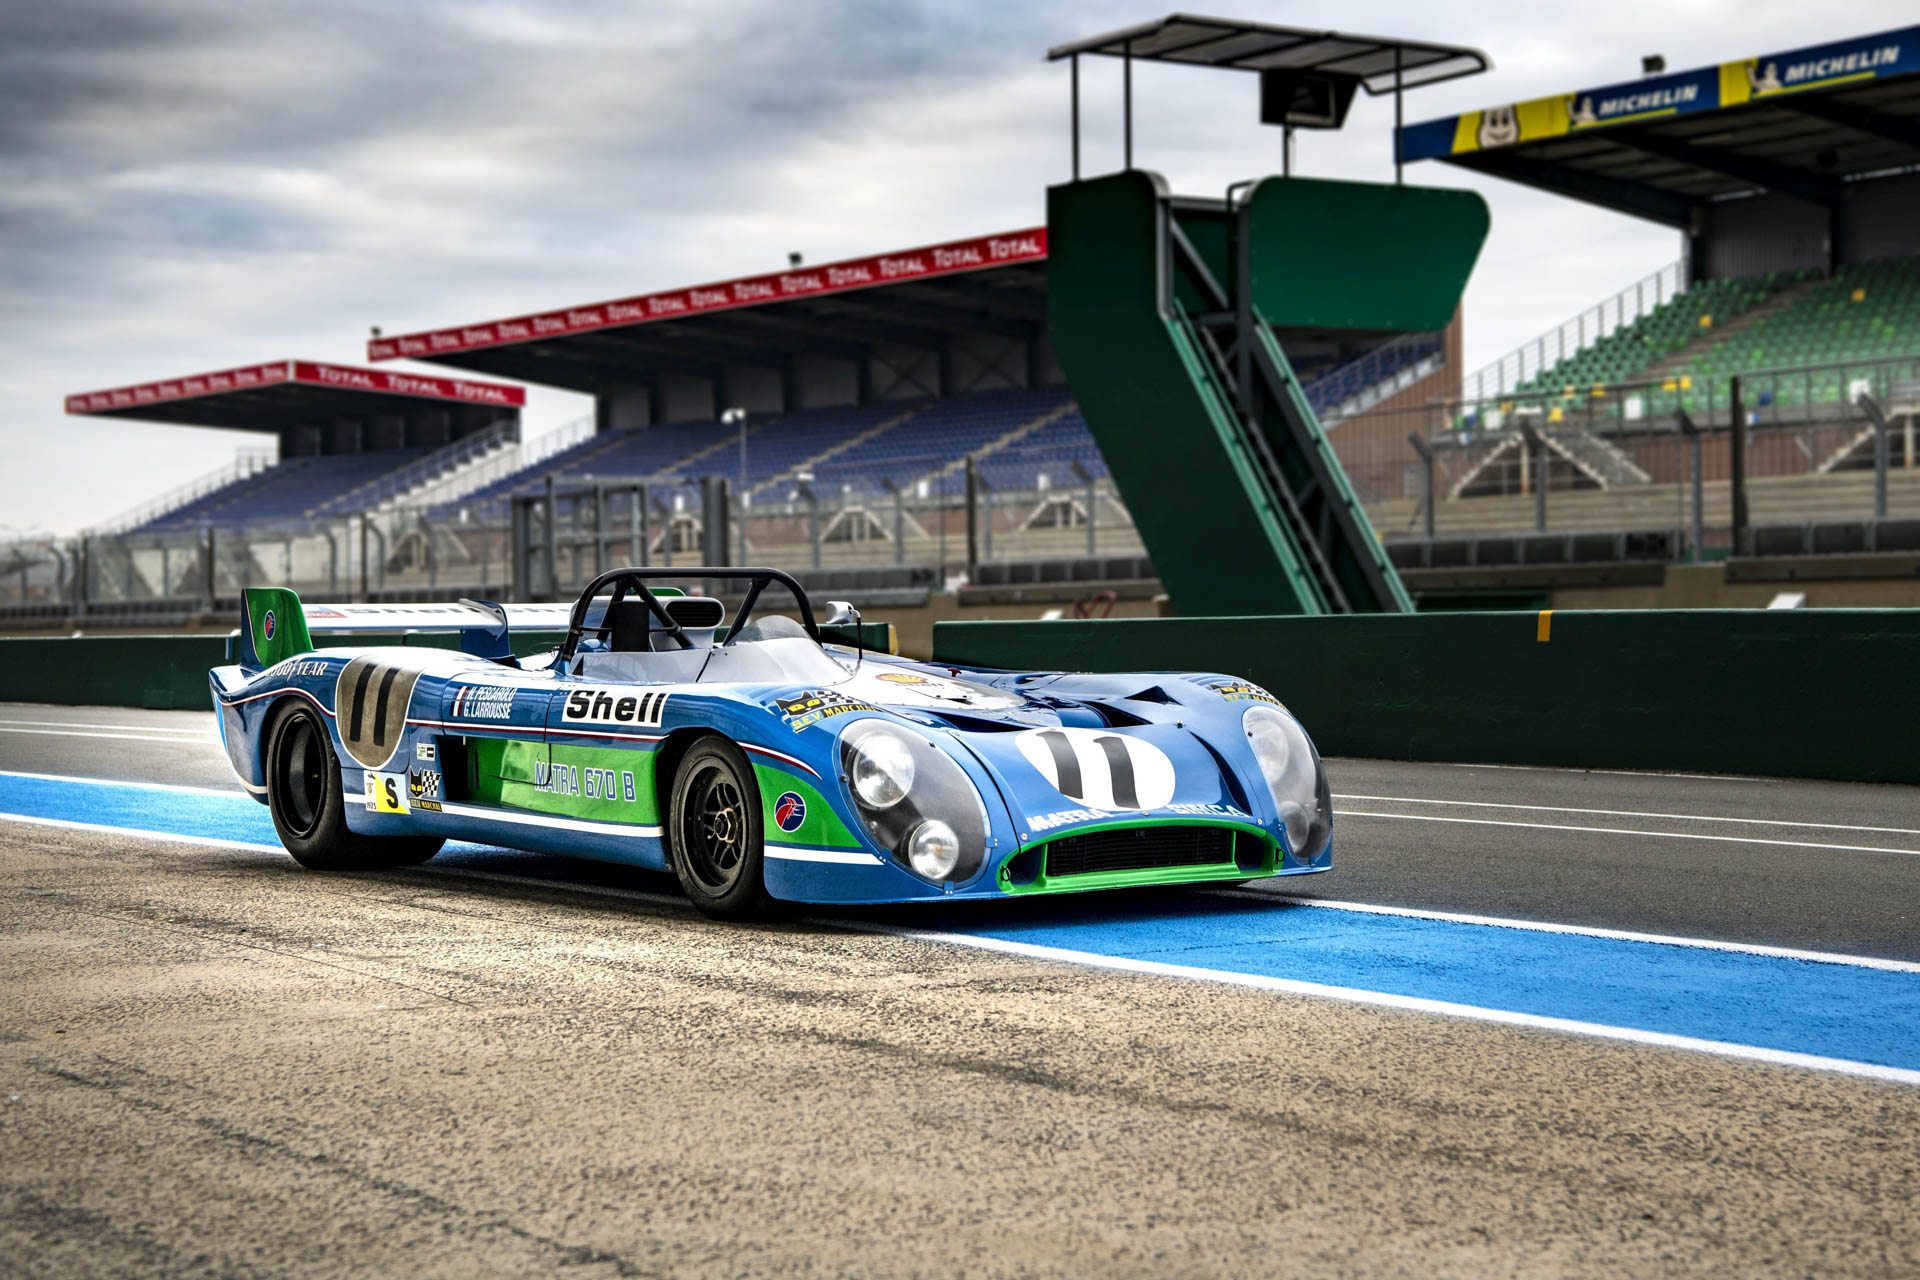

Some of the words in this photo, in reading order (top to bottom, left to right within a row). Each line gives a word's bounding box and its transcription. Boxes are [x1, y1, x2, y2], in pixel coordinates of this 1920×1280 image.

[1785, 46, 1900, 83] MICHELIN
[1599, 85, 1698, 115] MICHELIN
[650, 298, 685, 313] TOTAL
[690, 290, 729, 307] TOTAL
[733, 282, 775, 299] TOTAL
[780, 275, 822, 292] TOTAL
[827, 267, 872, 285] TOTAL
[878, 258, 926, 276] TOTAL
[933, 248, 983, 267] TOTAL
[988, 238, 1041, 258] TOTAL
[316, 367, 374, 387] TOTAL
[385, 375, 442, 395] TOTAL
[453, 382, 508, 402] TOTAL
[268, 659, 329, 681] OODYEAR
[349, 663, 401, 747] 11
[464, 701, 471, 717] G.
[471, 702, 512, 719] LARROUSSE
[566, 690, 667, 723] Shell
[534, 761, 580, 796] MATRA
[584, 767, 617, 800] 670
[622, 770, 637, 802] B
[1036, 730, 1141, 809] 11
[385, 777, 399, 809] S
[1025, 808, 1113, 833] MATRA
[1166, 803, 1251, 818] SIMCA
